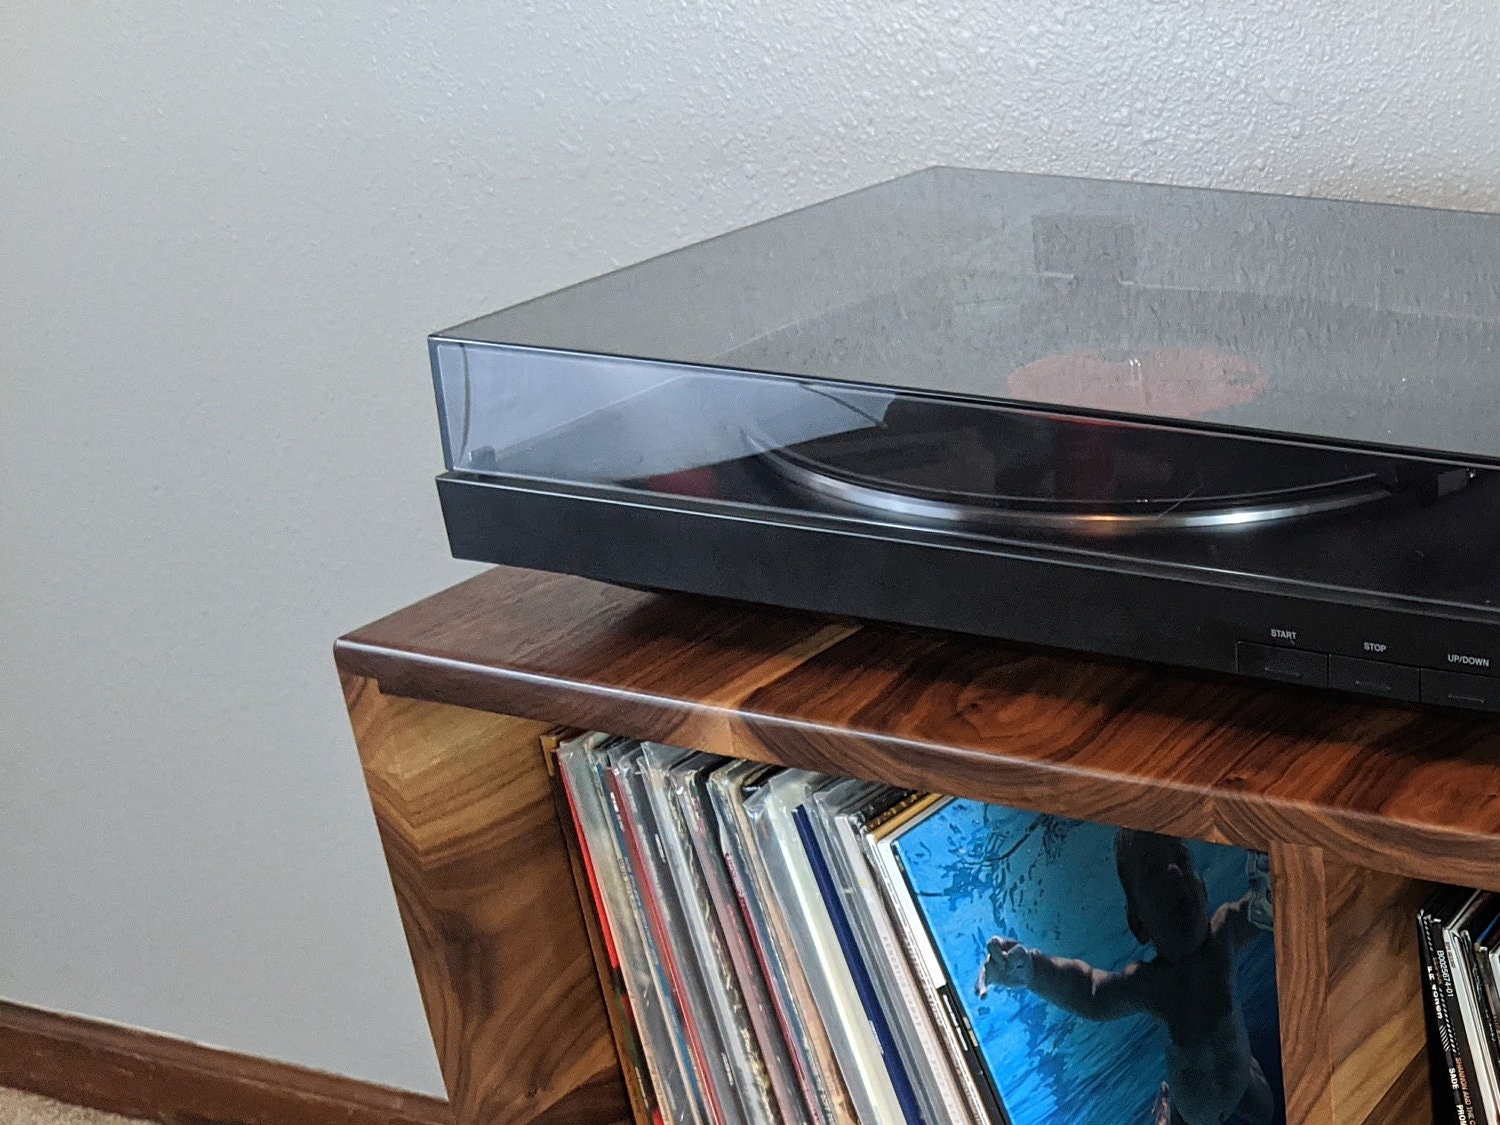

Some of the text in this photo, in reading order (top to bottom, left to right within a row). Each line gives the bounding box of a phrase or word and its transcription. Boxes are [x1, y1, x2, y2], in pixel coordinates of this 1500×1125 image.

[1270, 628, 1296, 640] START
[1363, 641, 1386, 653] STOP
[1447, 653, 1489, 667] UP/DOWN
[1447, 1067, 1459, 1089] SADE
